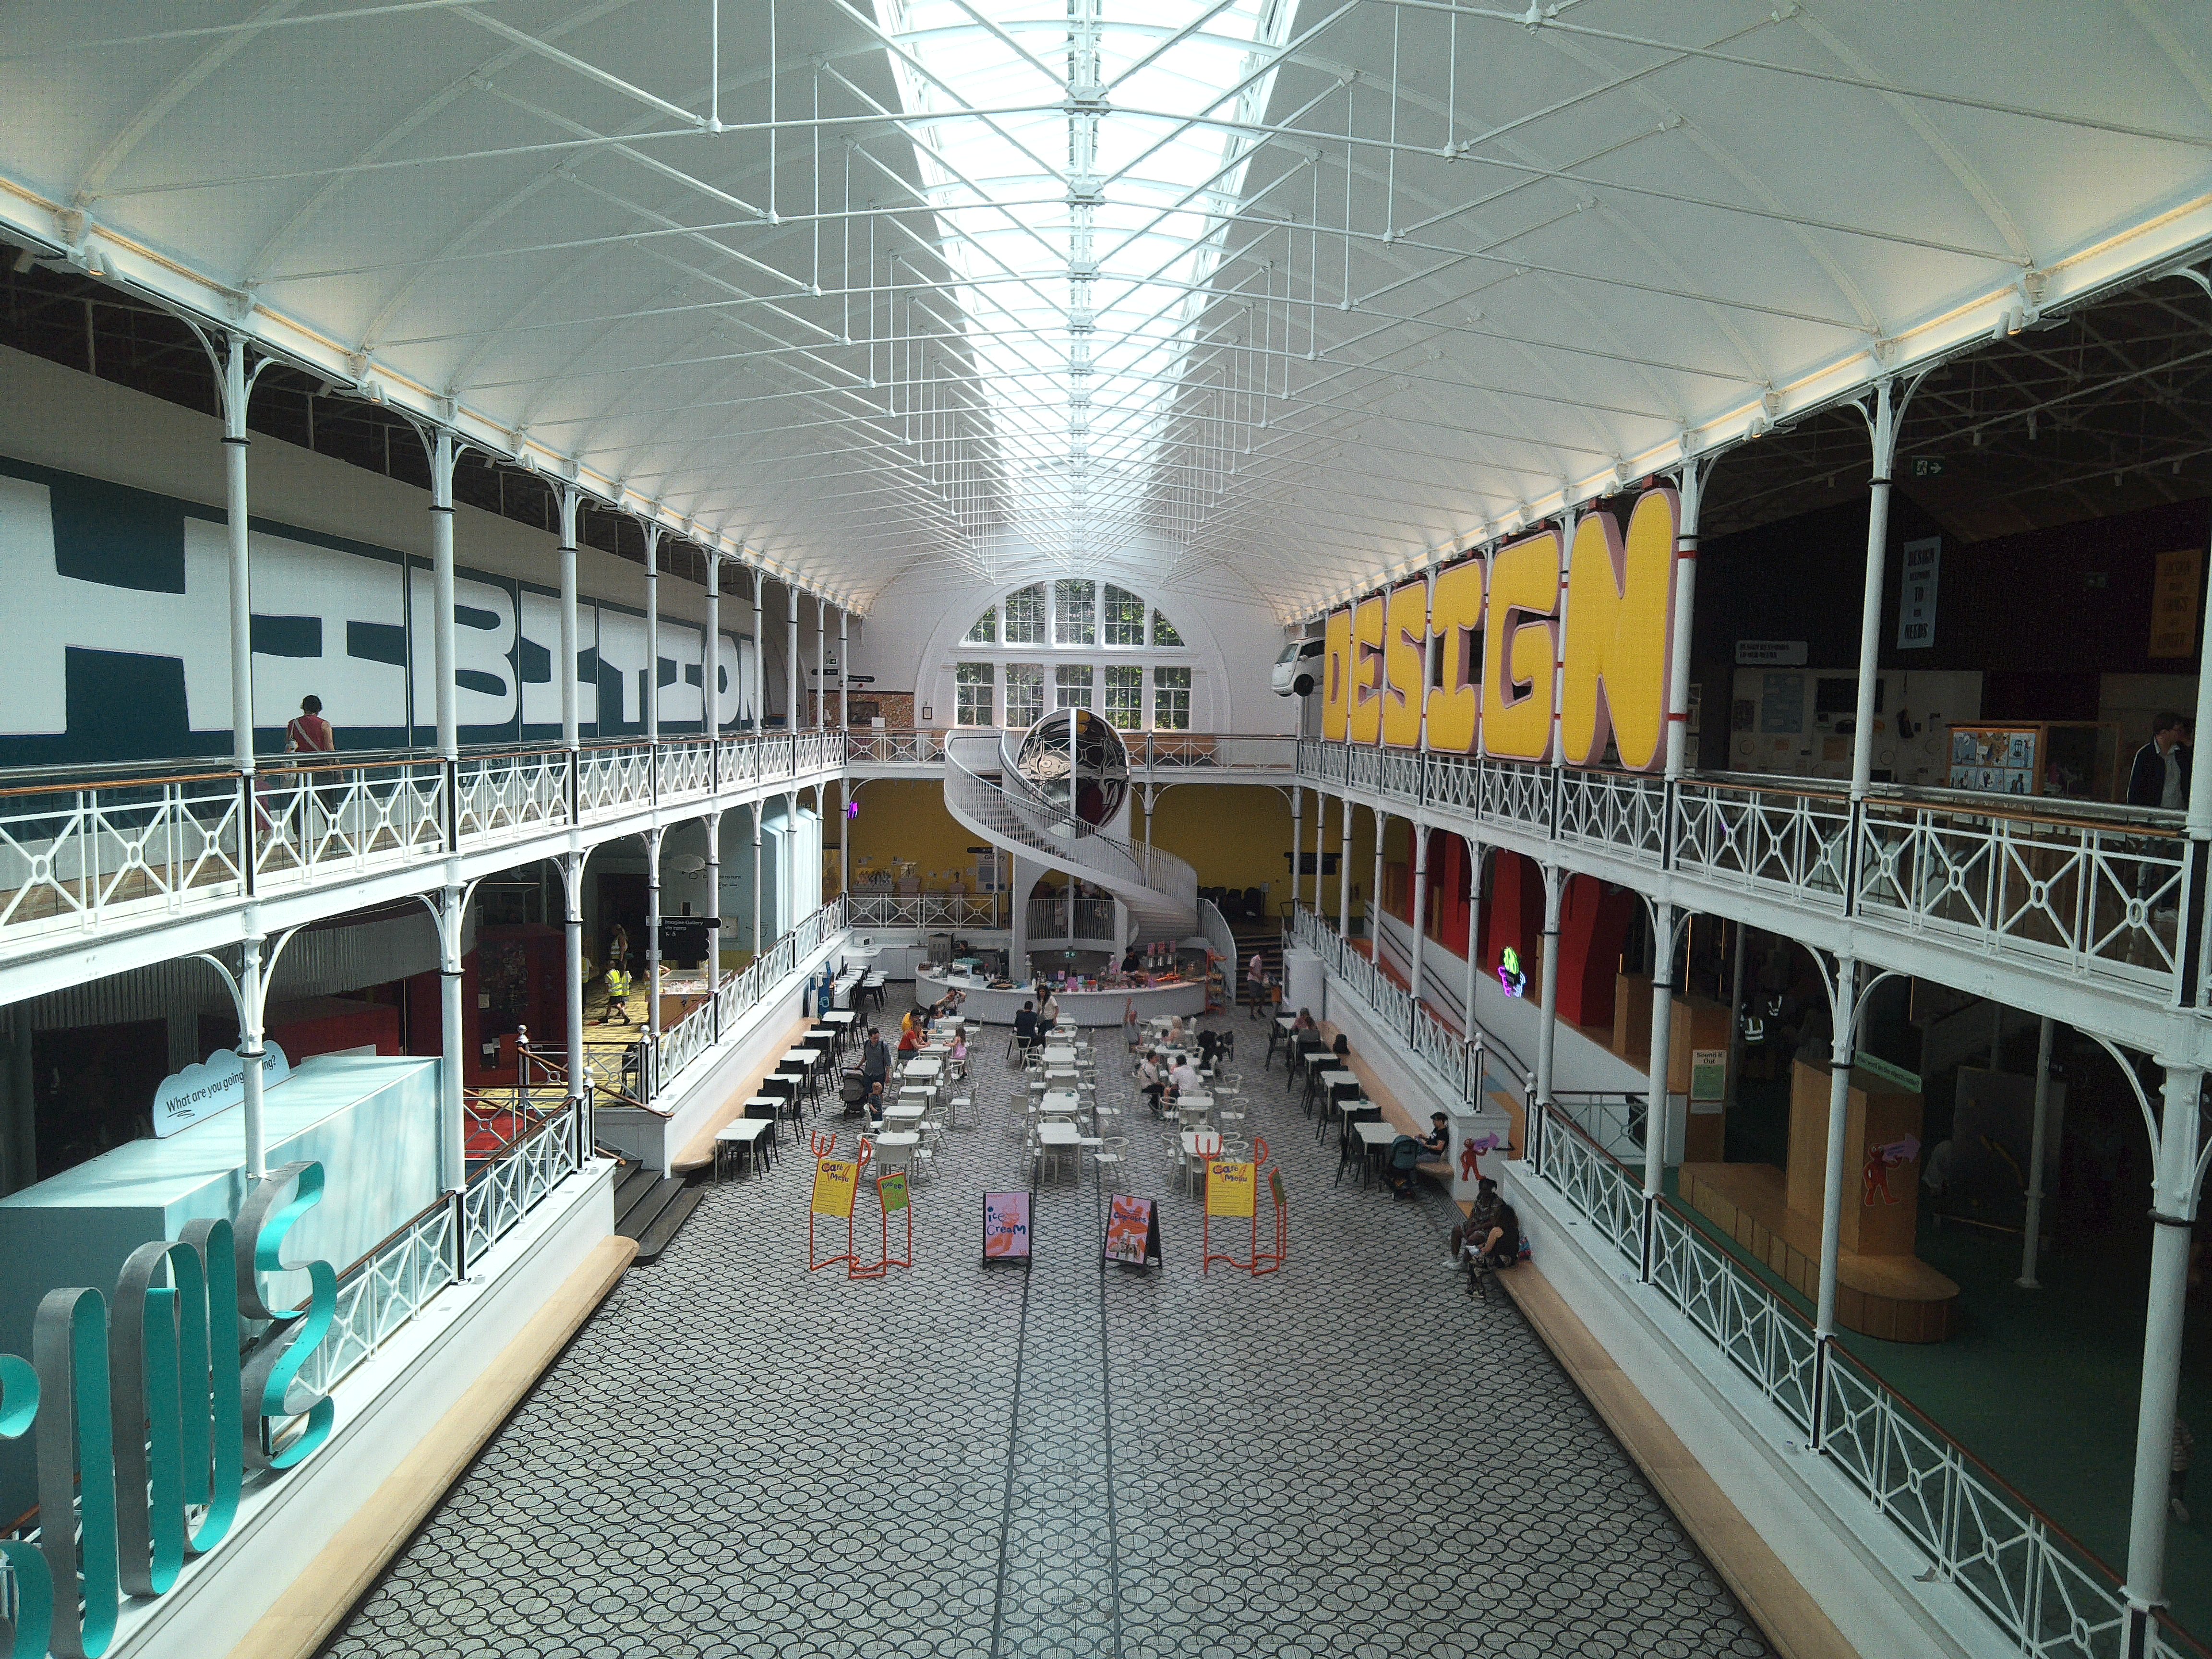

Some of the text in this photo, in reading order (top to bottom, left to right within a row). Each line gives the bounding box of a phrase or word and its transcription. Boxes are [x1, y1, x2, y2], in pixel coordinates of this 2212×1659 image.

[1908, 548, 1935, 566] DESIGN
[1322, 488, 1682, 772] DESIGN
[1904, 623, 1928, 640] NEEDS
[166, 1093, 192, 1113] What
[192, 1089, 207, 1102] are
[207, 1081, 222, 1098] you
[223, 1071, 244, 1091] going
[830, 1173, 849, 1183] Menu
[1224, 1174, 1248, 1182] Menu
